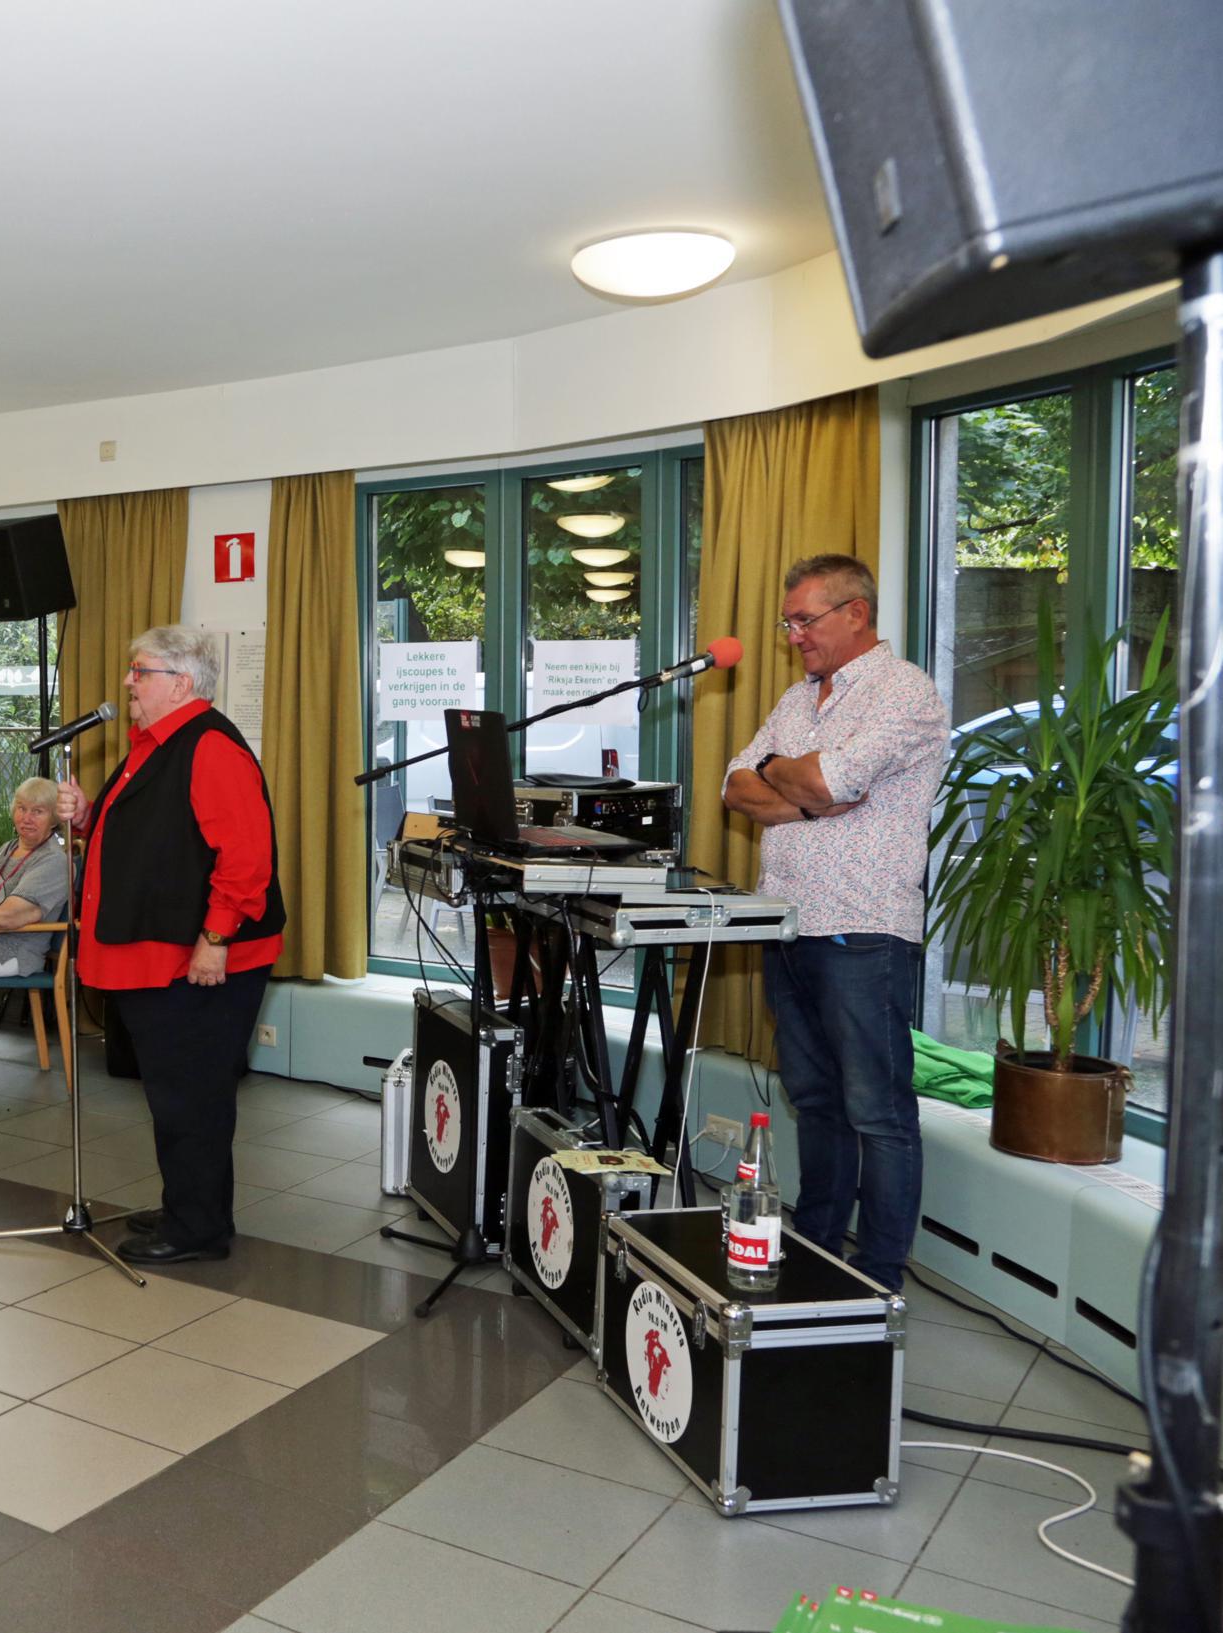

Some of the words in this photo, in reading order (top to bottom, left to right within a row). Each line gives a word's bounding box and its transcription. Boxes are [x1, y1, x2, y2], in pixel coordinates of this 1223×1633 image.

[406, 651, 446, 661] Lekkere
[396, 667, 444, 678] ijscoupes
[447, 667, 457, 676] te
[545, 662, 568, 671] Neem
[570, 663, 584, 671] een
[585, 662, 607, 672] kijkje
[609, 662, 620, 672] bij
[607, 677, 618, 685] en
[388, 681, 437, 693] verkrijgen
[440, 681, 450, 691] in
[452, 681, 466, 691] de
[543, 688, 566, 697] maak
[566, 689, 581, 697] een
[392, 699, 417, 709] gang
[420, 699, 461, 707] vooraan
[535, 1161, 550, 1184] Radio
[552, 1164, 571, 1213] Minerva
[728, 1242, 766, 1259] RDAL
[531, 1240, 562, 1287] Antwerpen
[632, 1287, 653, 1316] Radio
[655, 1289, 685, 1348] Minerva
[634, 1384, 681, 1440] Antwerpen
